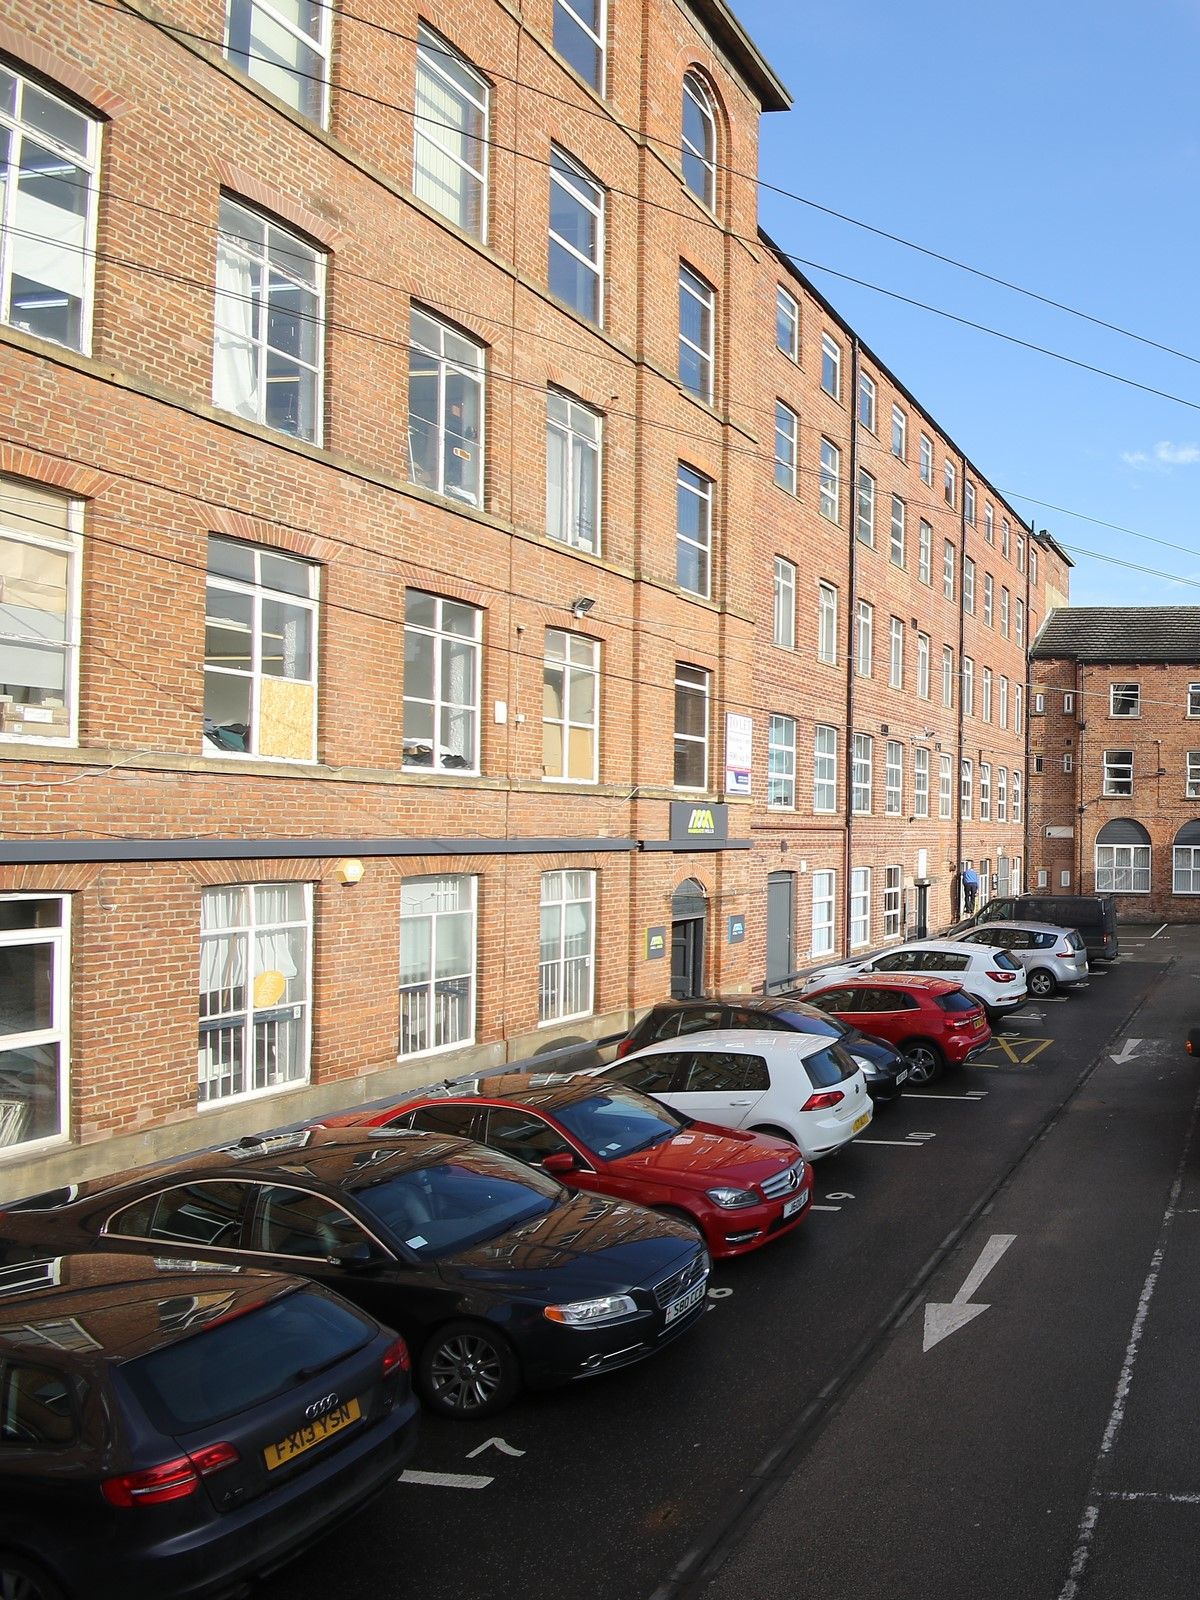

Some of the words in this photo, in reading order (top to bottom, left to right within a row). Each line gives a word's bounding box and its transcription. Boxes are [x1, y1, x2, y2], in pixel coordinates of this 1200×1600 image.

[905, 1132, 936, 1140] 10
[275, 1426, 317, 1460] FX13
[319, 1403, 351, 1434] YSN
